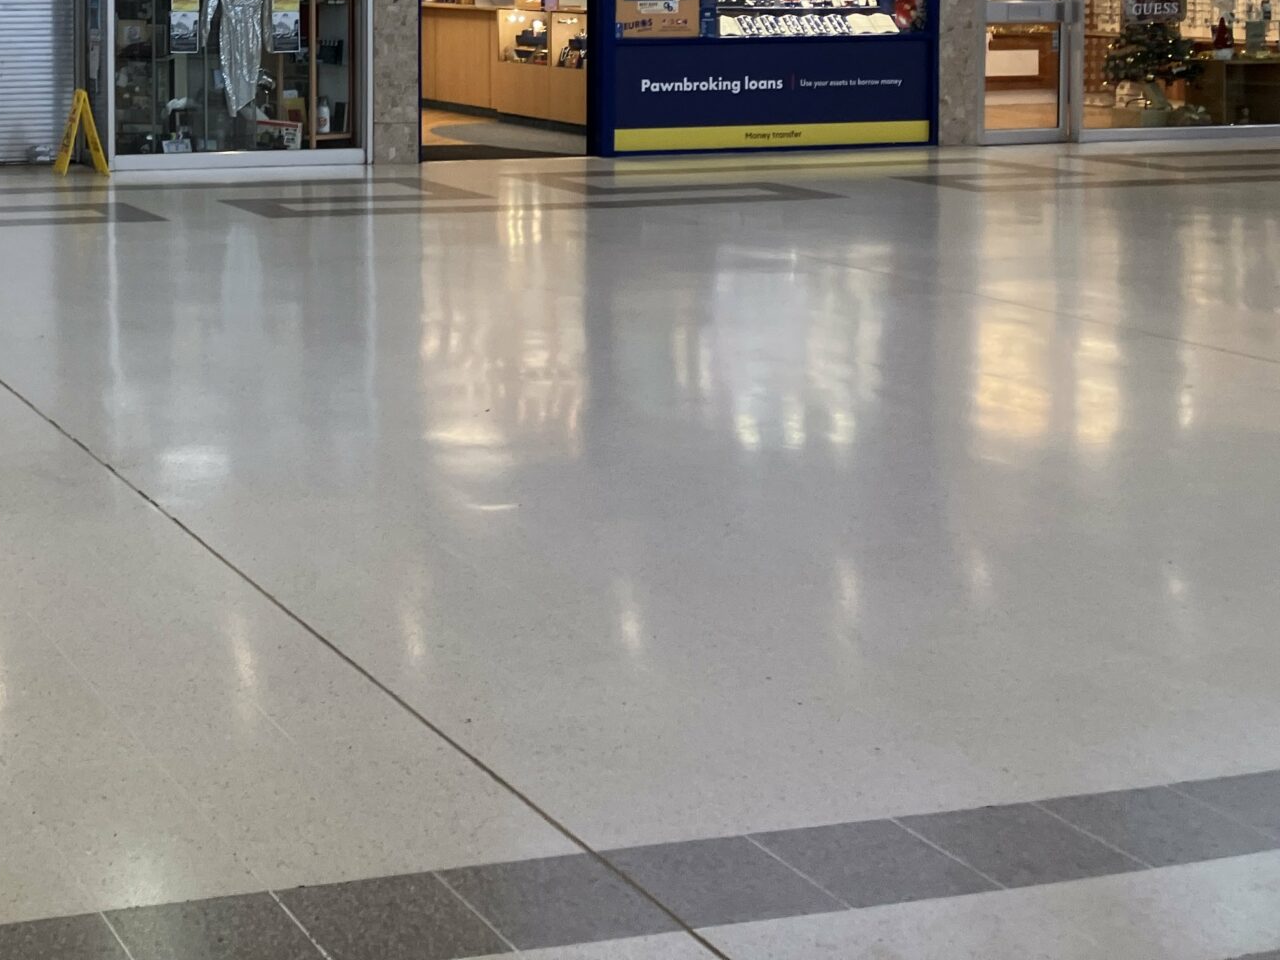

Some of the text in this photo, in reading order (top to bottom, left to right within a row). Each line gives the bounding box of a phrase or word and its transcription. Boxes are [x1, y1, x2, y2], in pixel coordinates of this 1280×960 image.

[1131, 1, 1180, 16] GUESS
[641, 77, 741, 94] Pawnbroking
[744, 75, 784, 90] loans
[799, 78, 812, 87] Use
[744, 129, 802, 141] Money transfer
